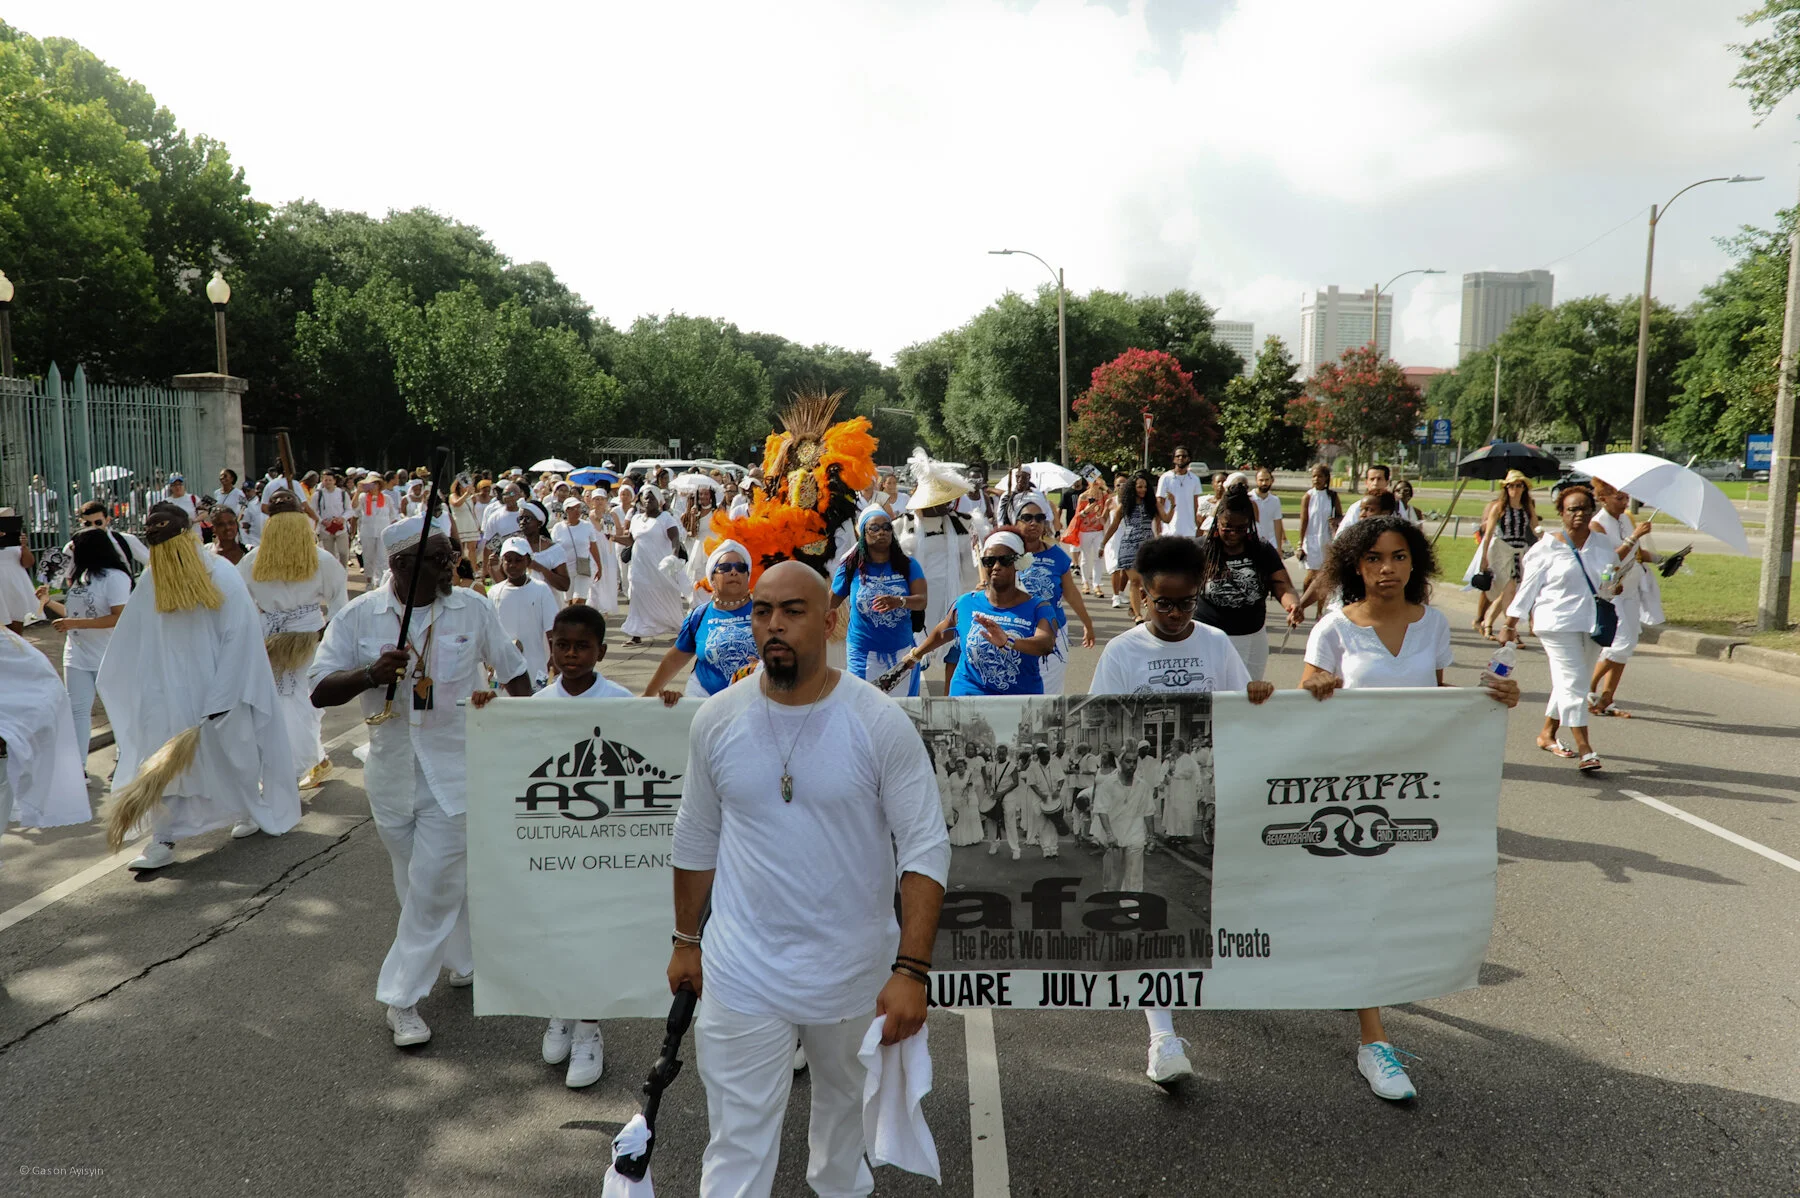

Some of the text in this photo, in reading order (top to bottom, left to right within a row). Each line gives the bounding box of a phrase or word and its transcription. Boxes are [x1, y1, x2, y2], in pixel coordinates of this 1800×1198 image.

[1266, 772, 1441, 805] MAAFA:
[516, 823, 674, 840] CULTURAL ARTS CENTE
[1265, 829, 1434, 845] REMEMBRANCE AND RENEWAL
[529, 856, 577, 871] NEW
[938, 877, 1170, 931] afa
[950, 930, 977, 960] The
[980, 930, 1015, 960] Past
[1018, 930, 1043, 960] We
[1137, 931, 1185, 960] Future
[1190, 927, 1214, 959] We
[1218, 927, 1271, 958] Create
[926, 971, 1203, 1010] QUARE JULY 1, 2017
